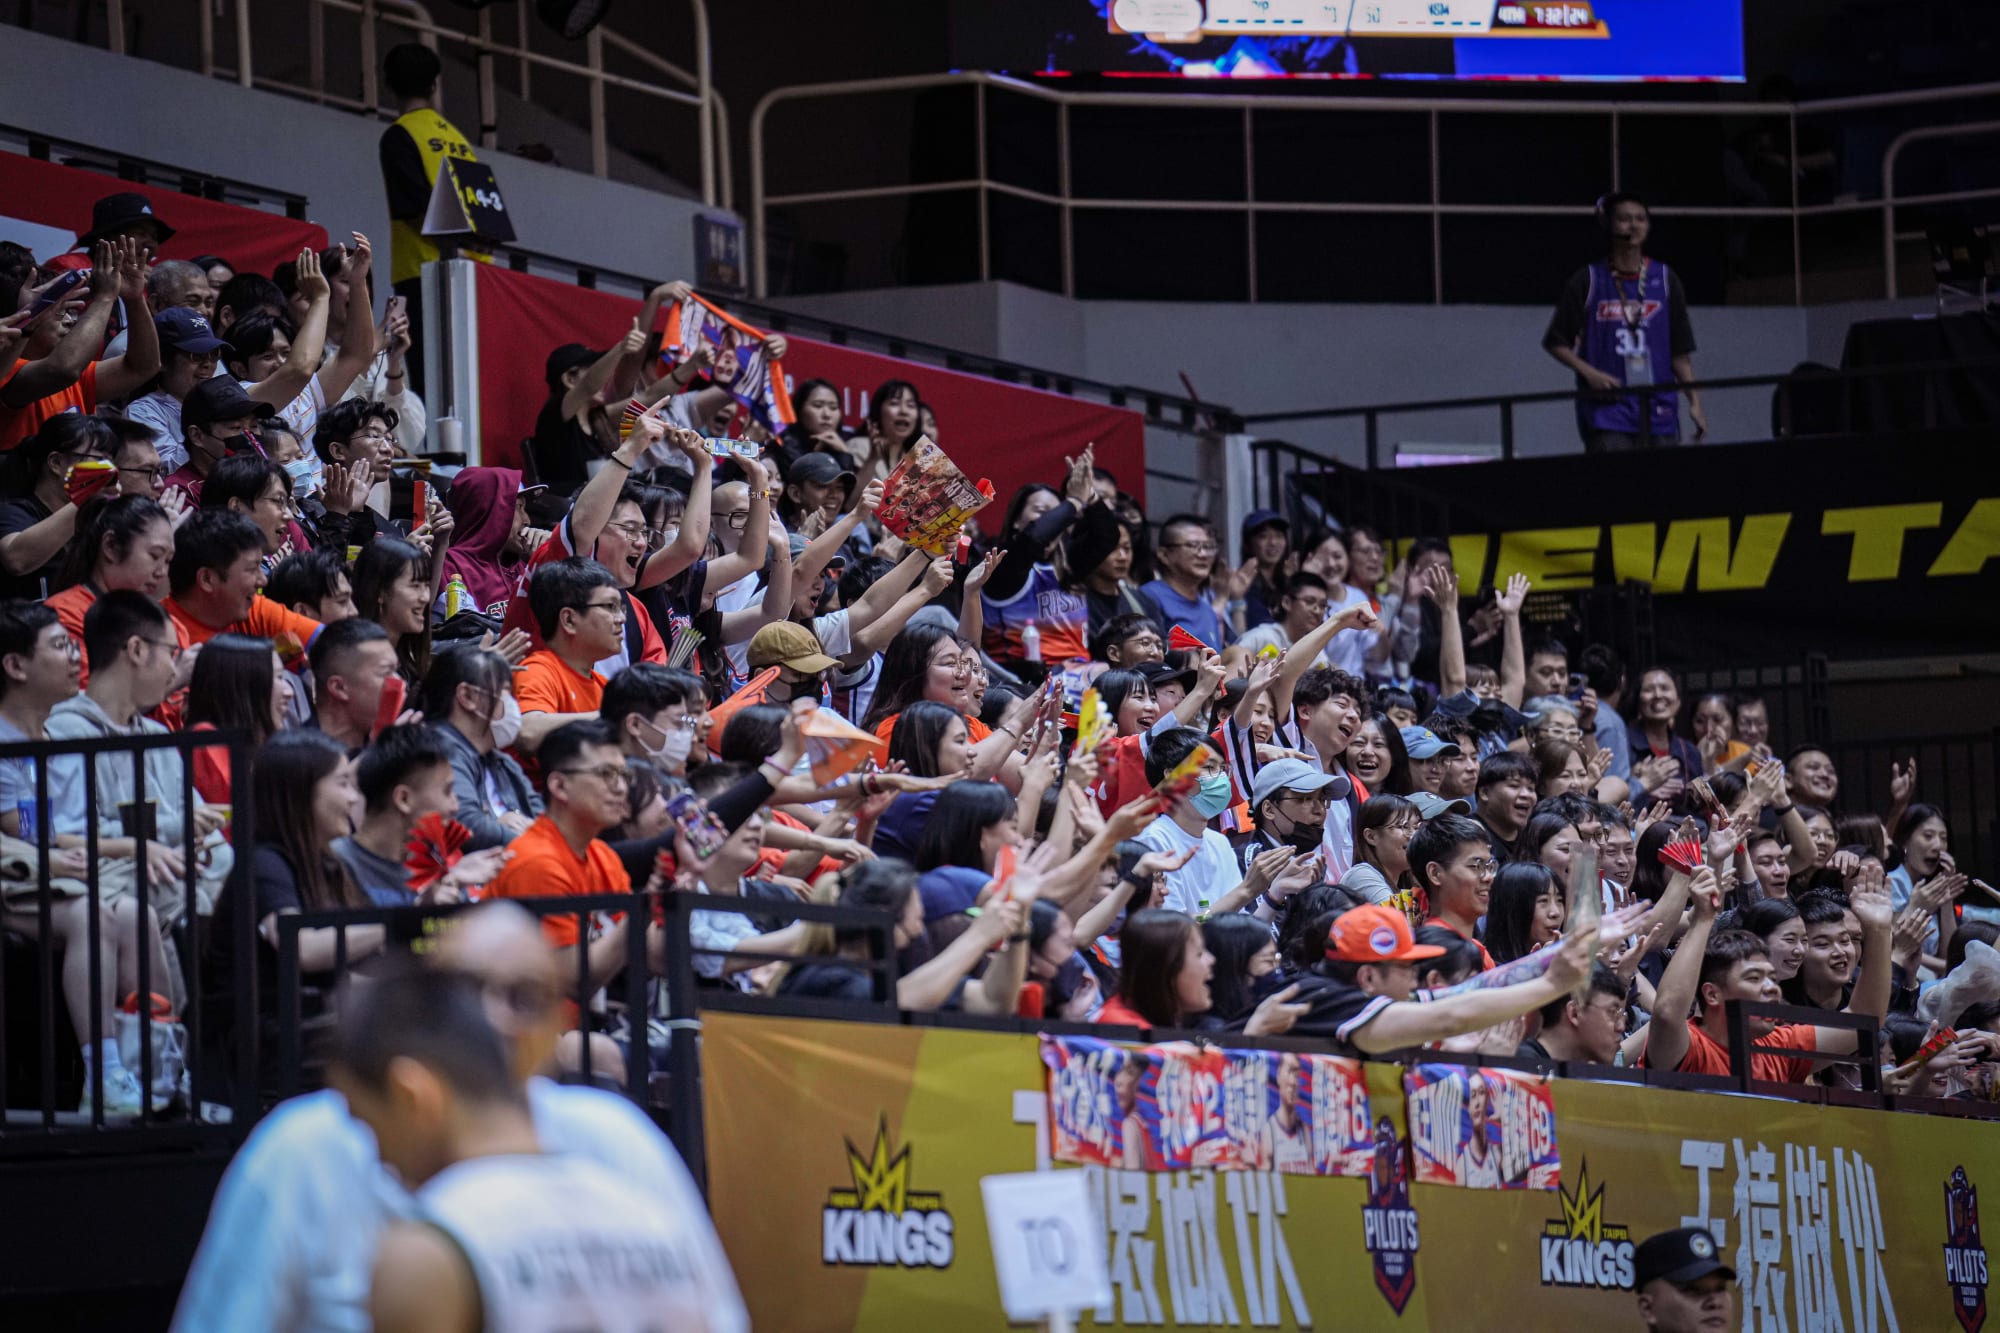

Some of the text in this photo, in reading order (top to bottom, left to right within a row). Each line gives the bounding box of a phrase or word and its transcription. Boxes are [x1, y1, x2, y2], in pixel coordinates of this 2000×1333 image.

[1530, 1094, 1551, 1162] 69
[823, 1208, 954, 1267] KINGS
[1363, 1208, 1419, 1250] PILOTS
[1540, 1237, 1637, 1289] KINGS
[1944, 1247, 1988, 1285] PILOTS
